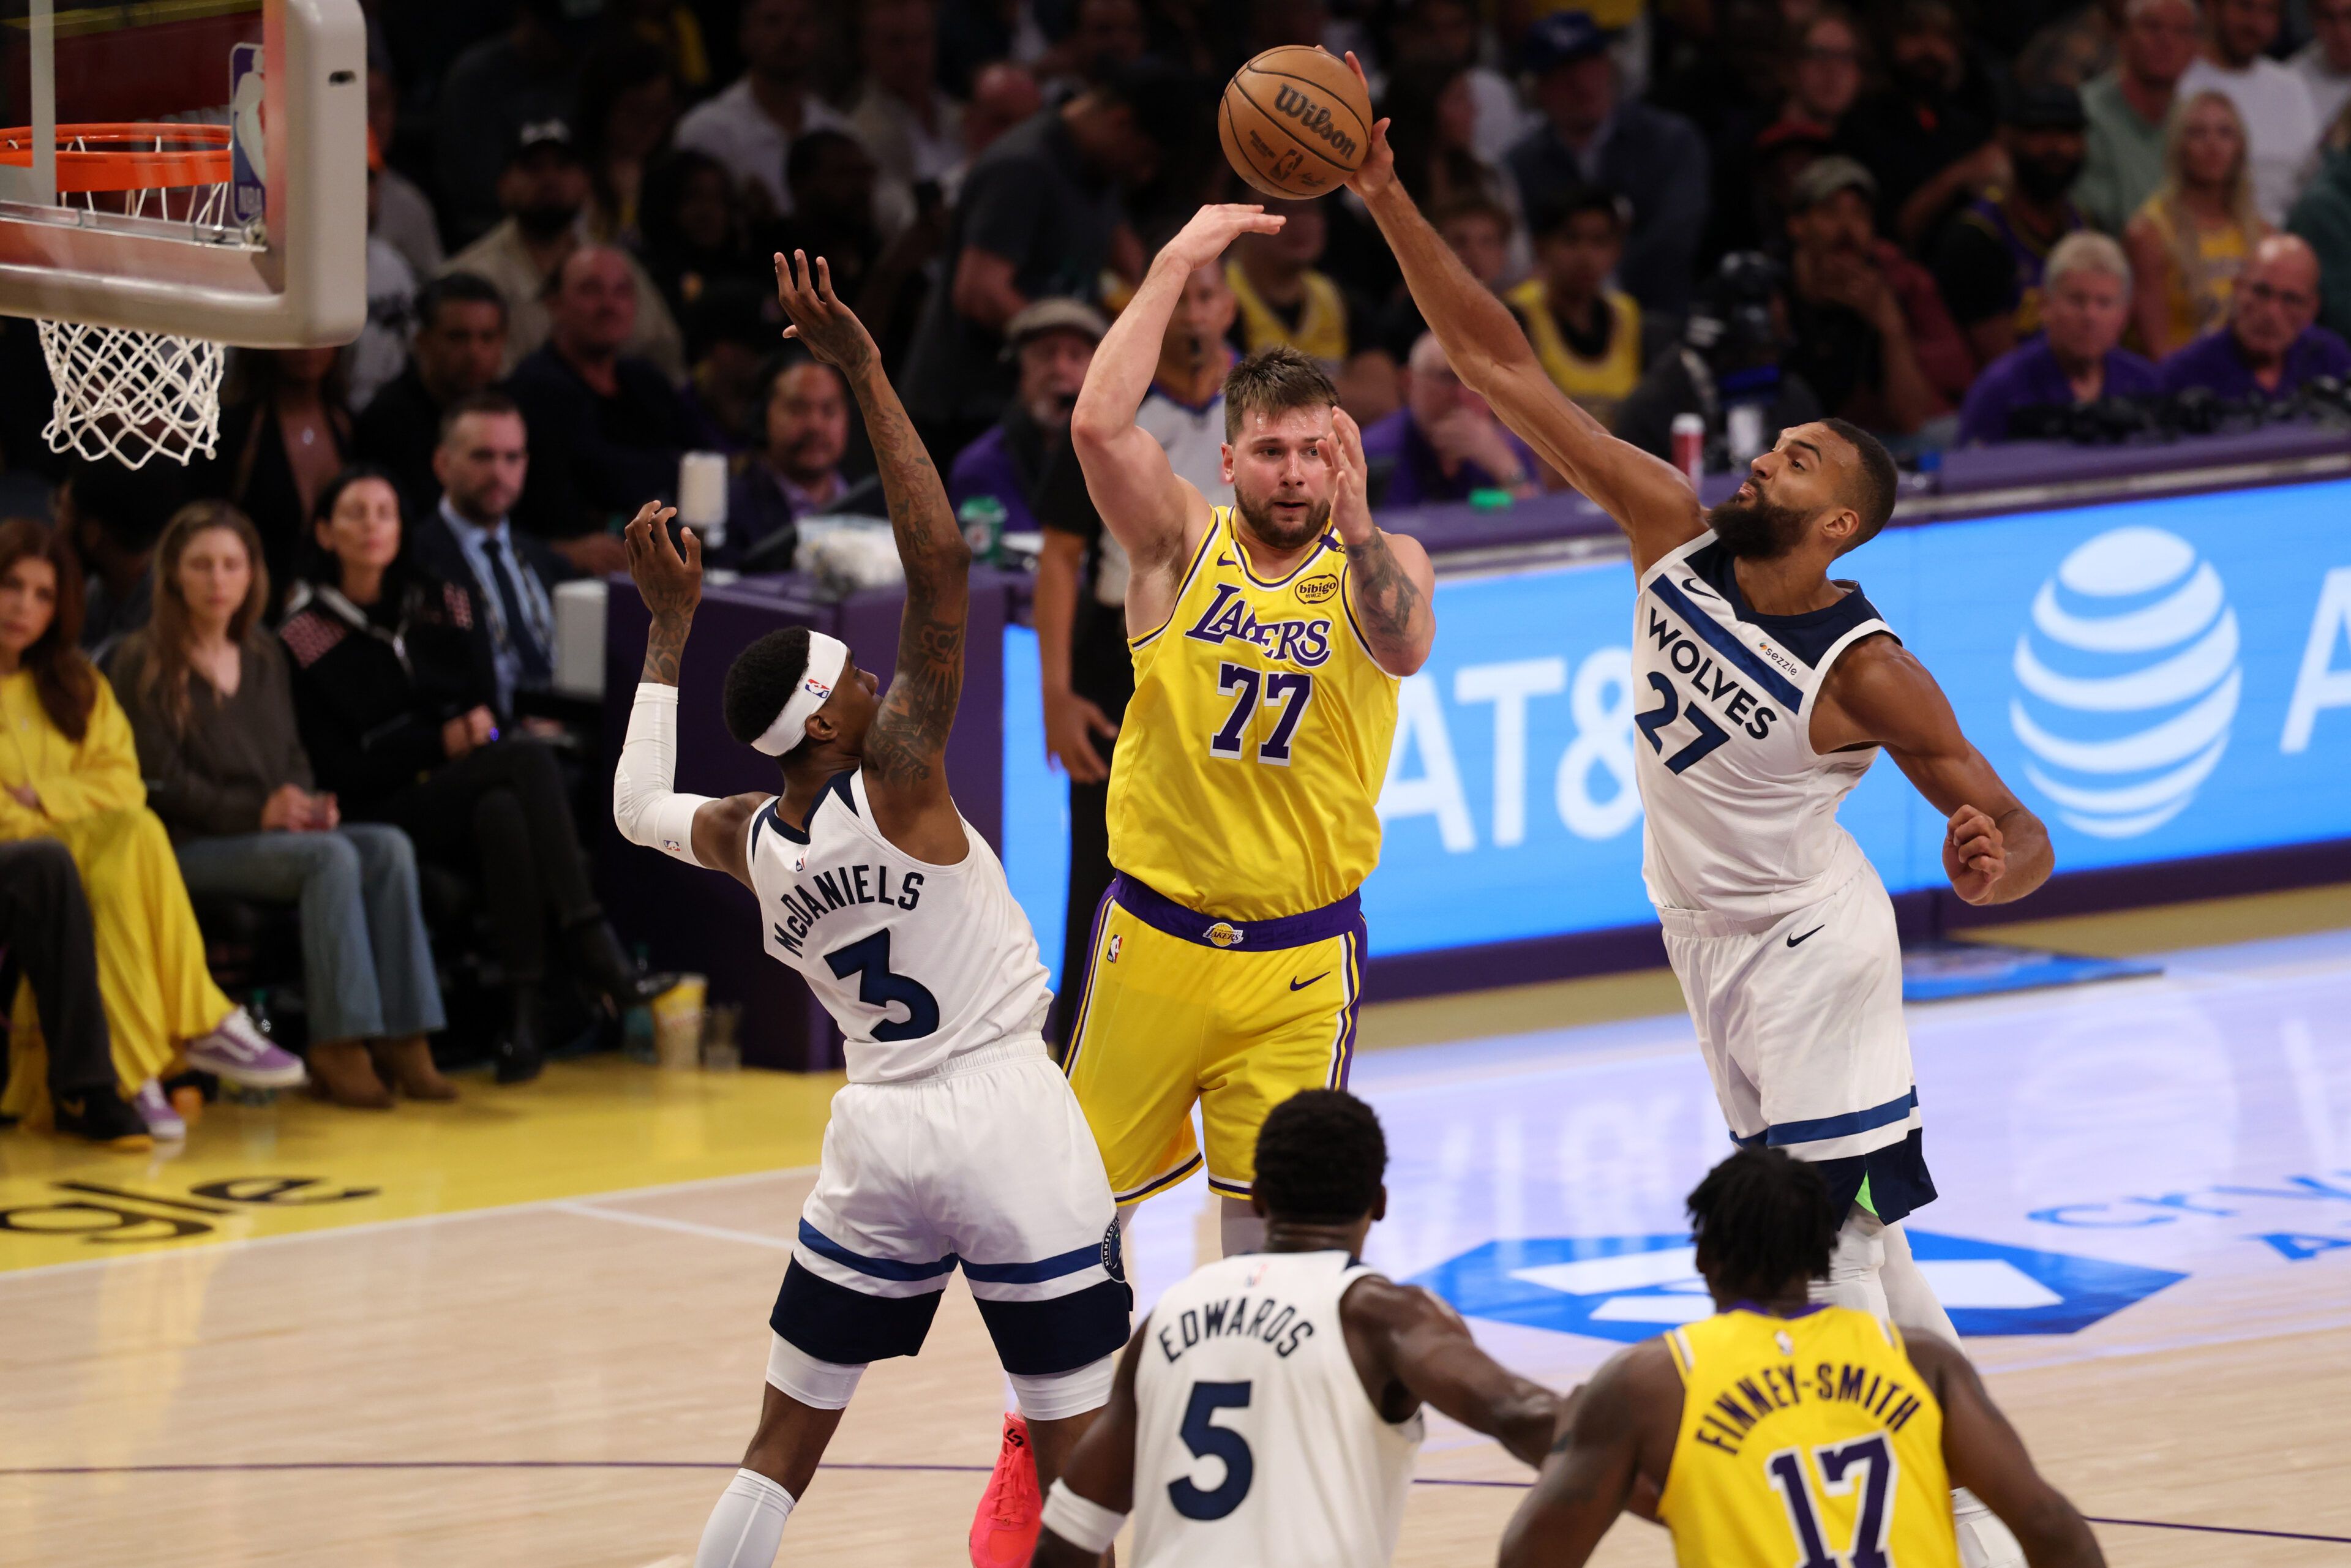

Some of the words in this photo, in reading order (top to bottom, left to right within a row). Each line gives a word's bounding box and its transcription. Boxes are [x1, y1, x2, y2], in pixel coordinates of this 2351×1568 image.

[1275, 84, 1357, 160] Wilson
[1183, 582, 1333, 669] LAKERS
[1299, 582, 1337, 595] bibigo
[1649, 606, 1777, 740] WOLVES
[1765, 648, 1798, 675] sezzle
[1209, 661, 1313, 767] 77
[1379, 647, 1644, 853] AT&
[1635, 671, 1731, 776] 27
[774, 865, 925, 958] McDANIELS
[1204, 927, 1243, 943] LAKERS
[823, 928, 940, 1042] 3
[1159, 1297, 1314, 1364] EDWARDS
[1168, 1380, 1253, 1521] 5
[1694, 1363, 1922, 1456] FINNEY-SMITH
[1765, 1428, 1900, 1568] 17
